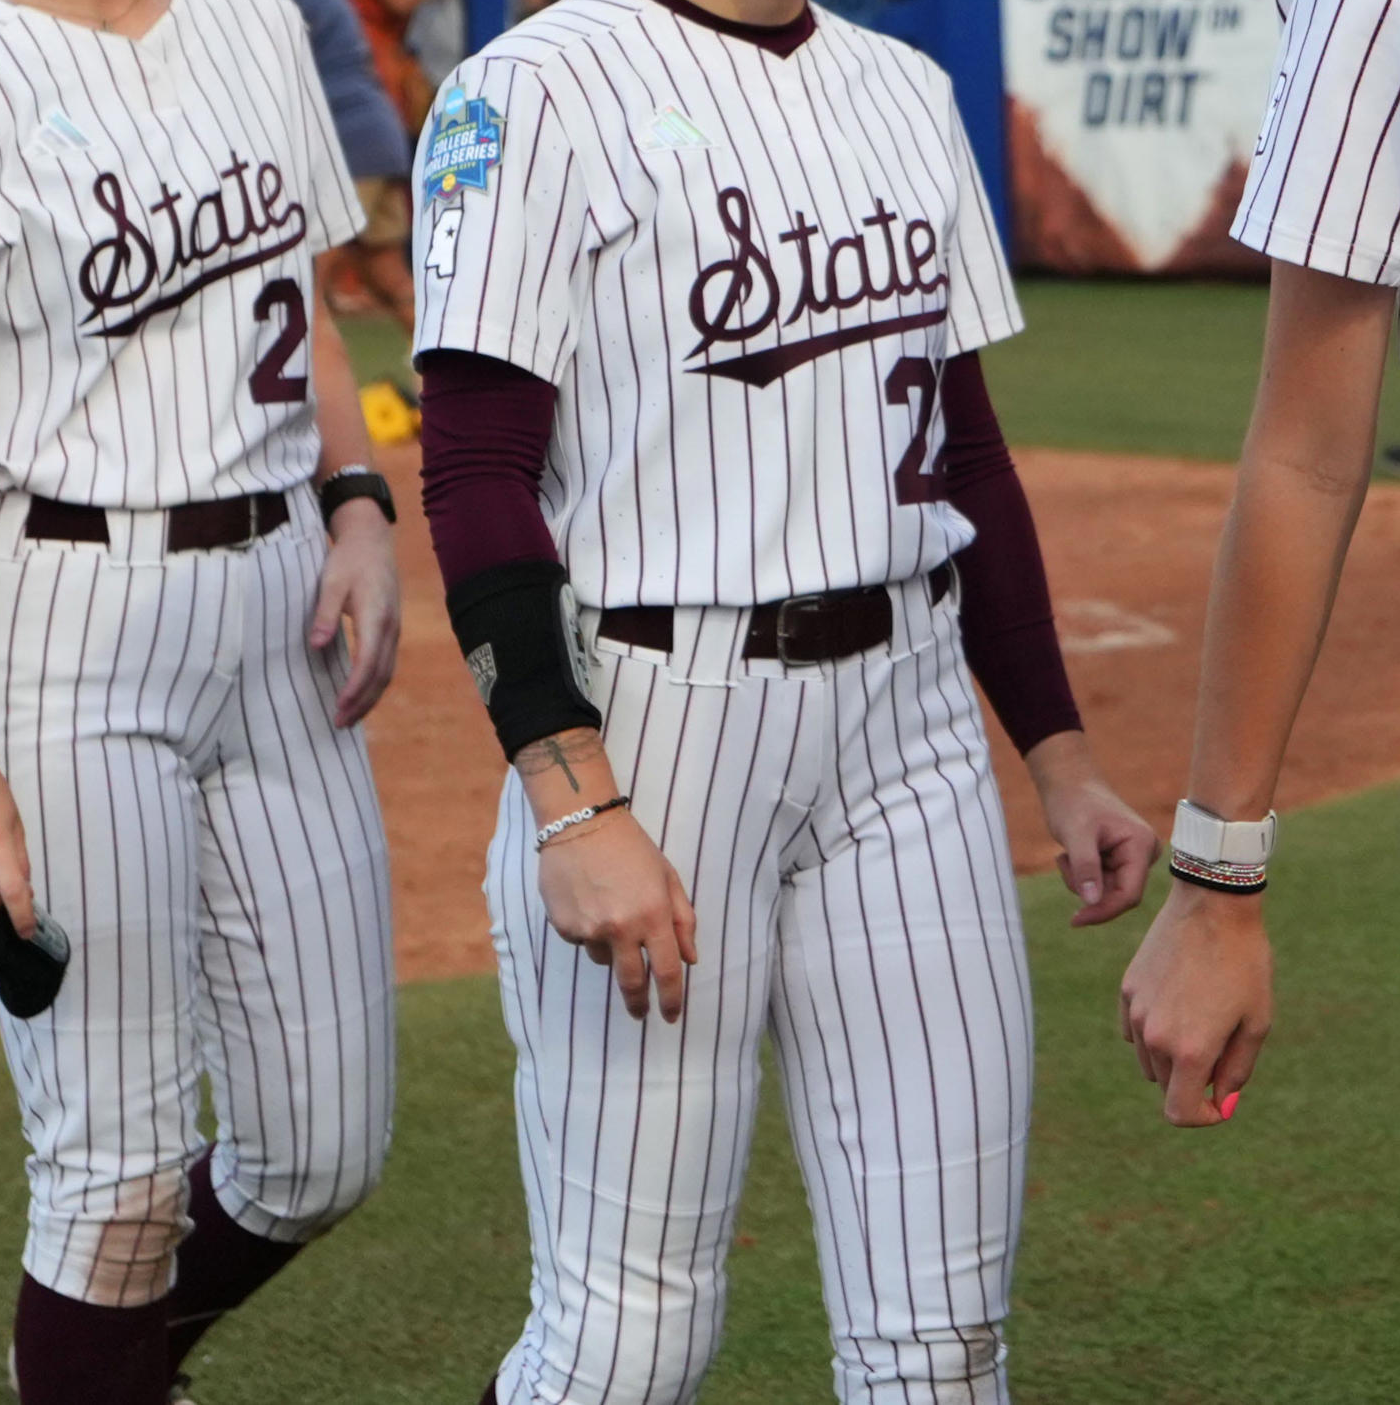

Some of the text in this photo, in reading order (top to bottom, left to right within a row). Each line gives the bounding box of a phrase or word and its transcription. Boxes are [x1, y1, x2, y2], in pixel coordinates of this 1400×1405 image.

[1045, 6, 1242, 62] SHOW ON
[1082, 71, 1201, 127] DIRT
[432, 129, 479, 158] COLLEGE
[450, 142, 498, 168] SERIES
[78, 150, 306, 337] State
[683, 187, 949, 384] State
[249, 277, 308, 405] 2
